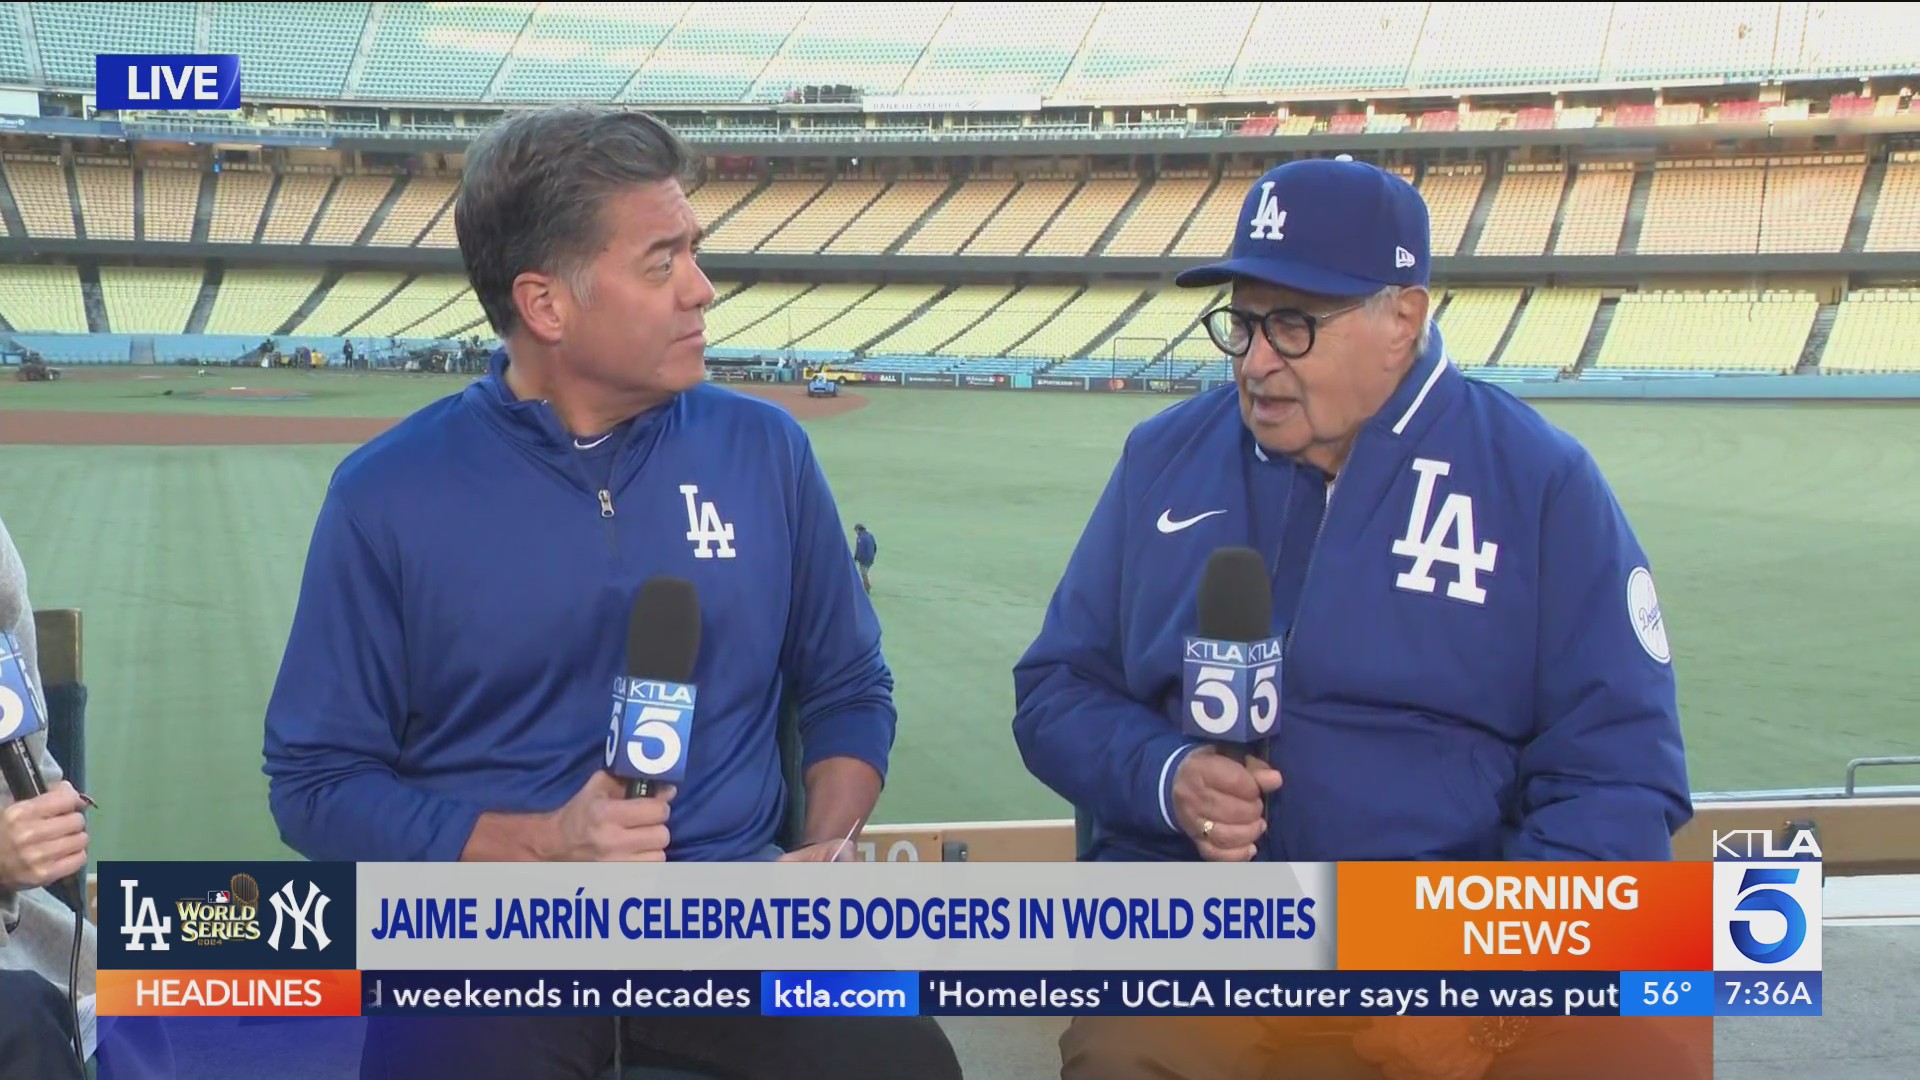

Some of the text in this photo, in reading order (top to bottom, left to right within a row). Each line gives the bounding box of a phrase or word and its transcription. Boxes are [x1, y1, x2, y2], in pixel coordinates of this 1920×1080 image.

[1249, 181, 1287, 240] LA
[679, 484, 736, 559] LA
[1391, 458, 1499, 605] LA
[1186, 639, 1245, 664] KTLA
[1248, 640, 1282, 662] KTLA
[630, 681, 692, 704] KTLA
[1190, 666, 1239, 735] 5
[1250, 665, 1279, 734] 5
[626, 706, 682, 775] 5
